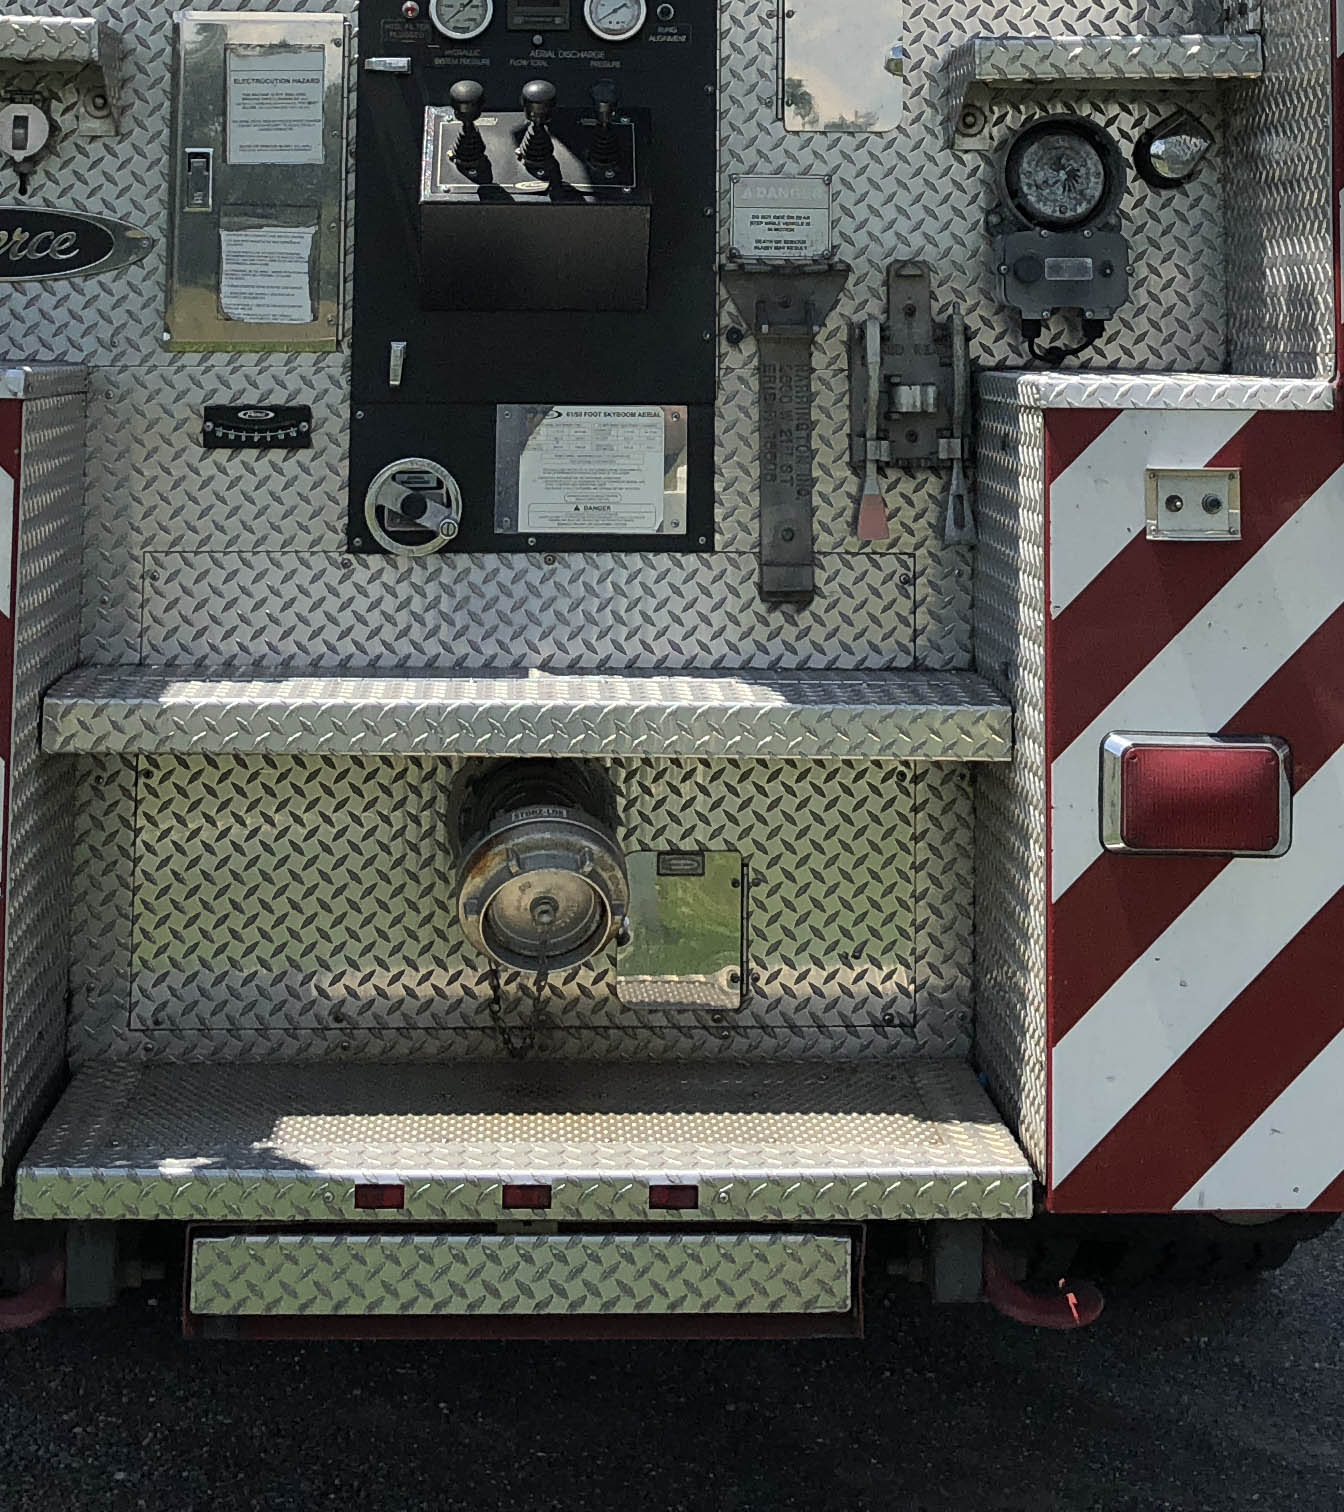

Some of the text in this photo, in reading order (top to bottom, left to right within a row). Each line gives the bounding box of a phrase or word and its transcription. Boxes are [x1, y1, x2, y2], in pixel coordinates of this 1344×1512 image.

[529, 50, 606, 59] AERIAL DISCHARGE
[756, 186, 825, 201] DANG
[763, 362, 777, 403] ERIE
